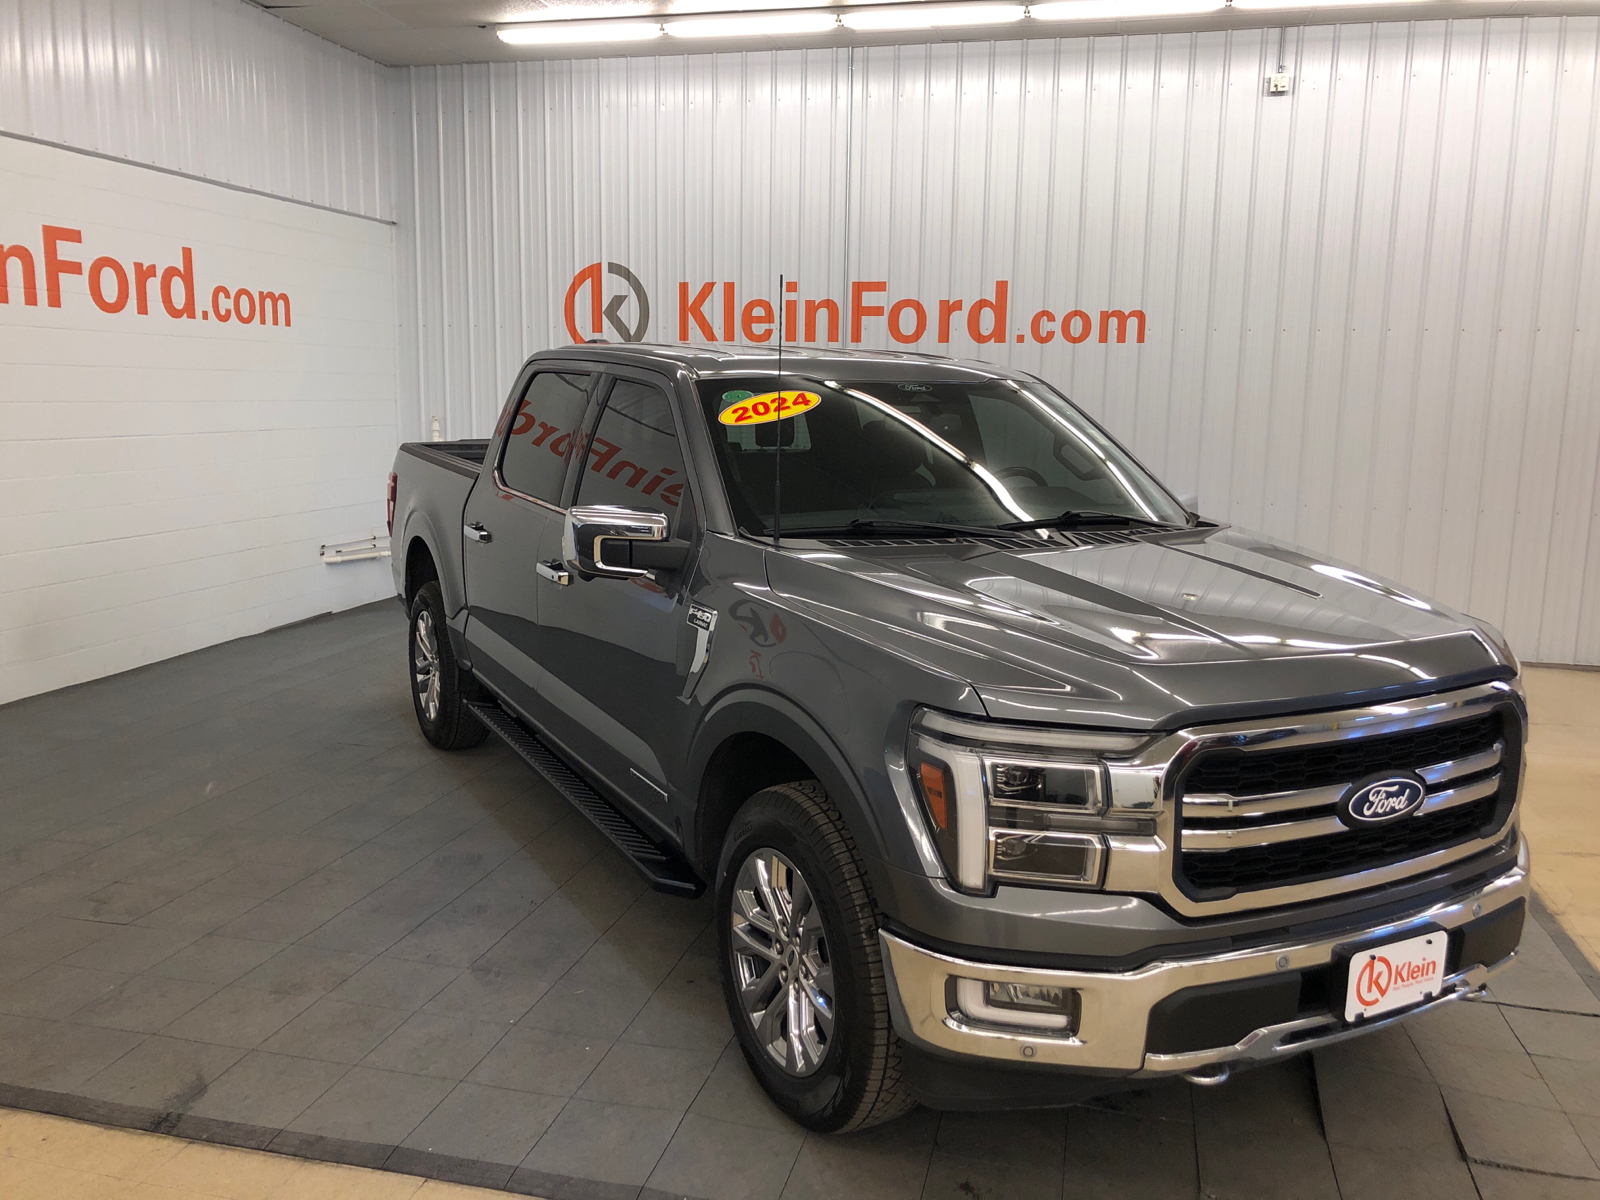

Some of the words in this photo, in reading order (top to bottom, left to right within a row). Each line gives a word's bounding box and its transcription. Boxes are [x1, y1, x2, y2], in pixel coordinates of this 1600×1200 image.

[678, 280, 1146, 344] KleinFord.com
[731, 392, 812, 423] 2024
[1363, 785, 1410, 816] Ford
[1393, 957, 1437, 985] Klein
